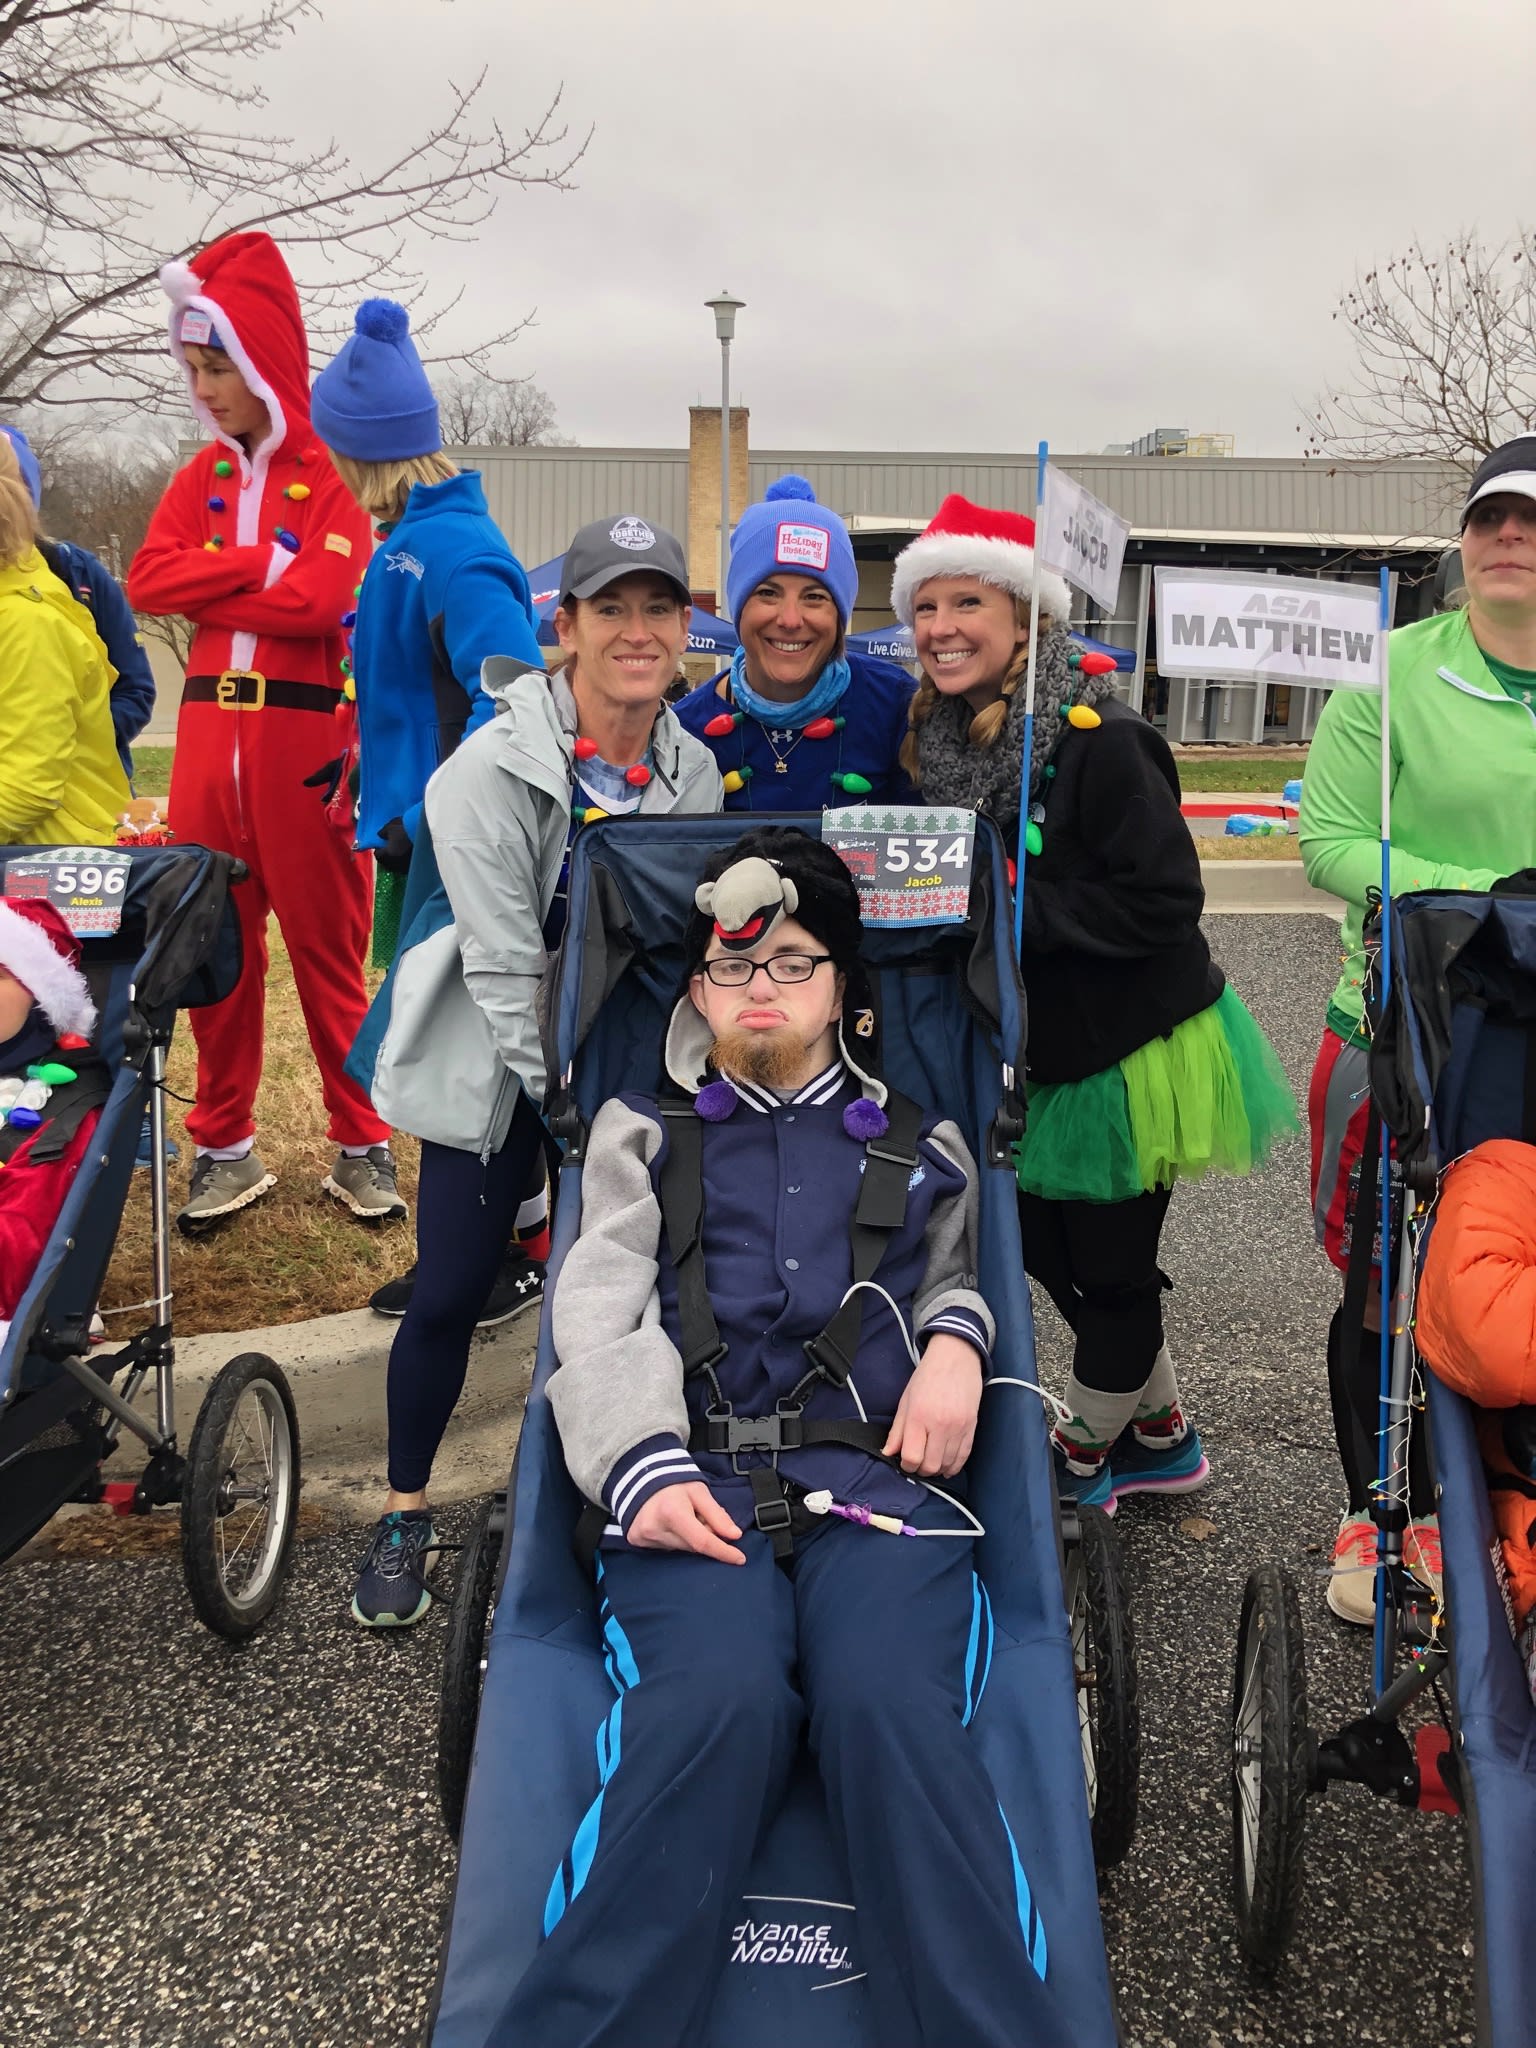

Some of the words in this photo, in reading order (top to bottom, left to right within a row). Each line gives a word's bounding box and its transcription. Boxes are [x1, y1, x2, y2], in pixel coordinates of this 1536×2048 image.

[1063, 516, 1108, 571] JACOB
[1242, 593, 1321, 620] ASA
[687, 632, 716, 650] Run
[1171, 614, 1374, 664] MATTHEW
[884, 836, 969, 873] 534
[54, 866, 126, 894] 596
[904, 875, 943, 888] Jacob
[70, 897, 104, 906] Alexis
[731, 1919, 832, 1941] dvance
[730, 1940, 848, 1969] Mobility
